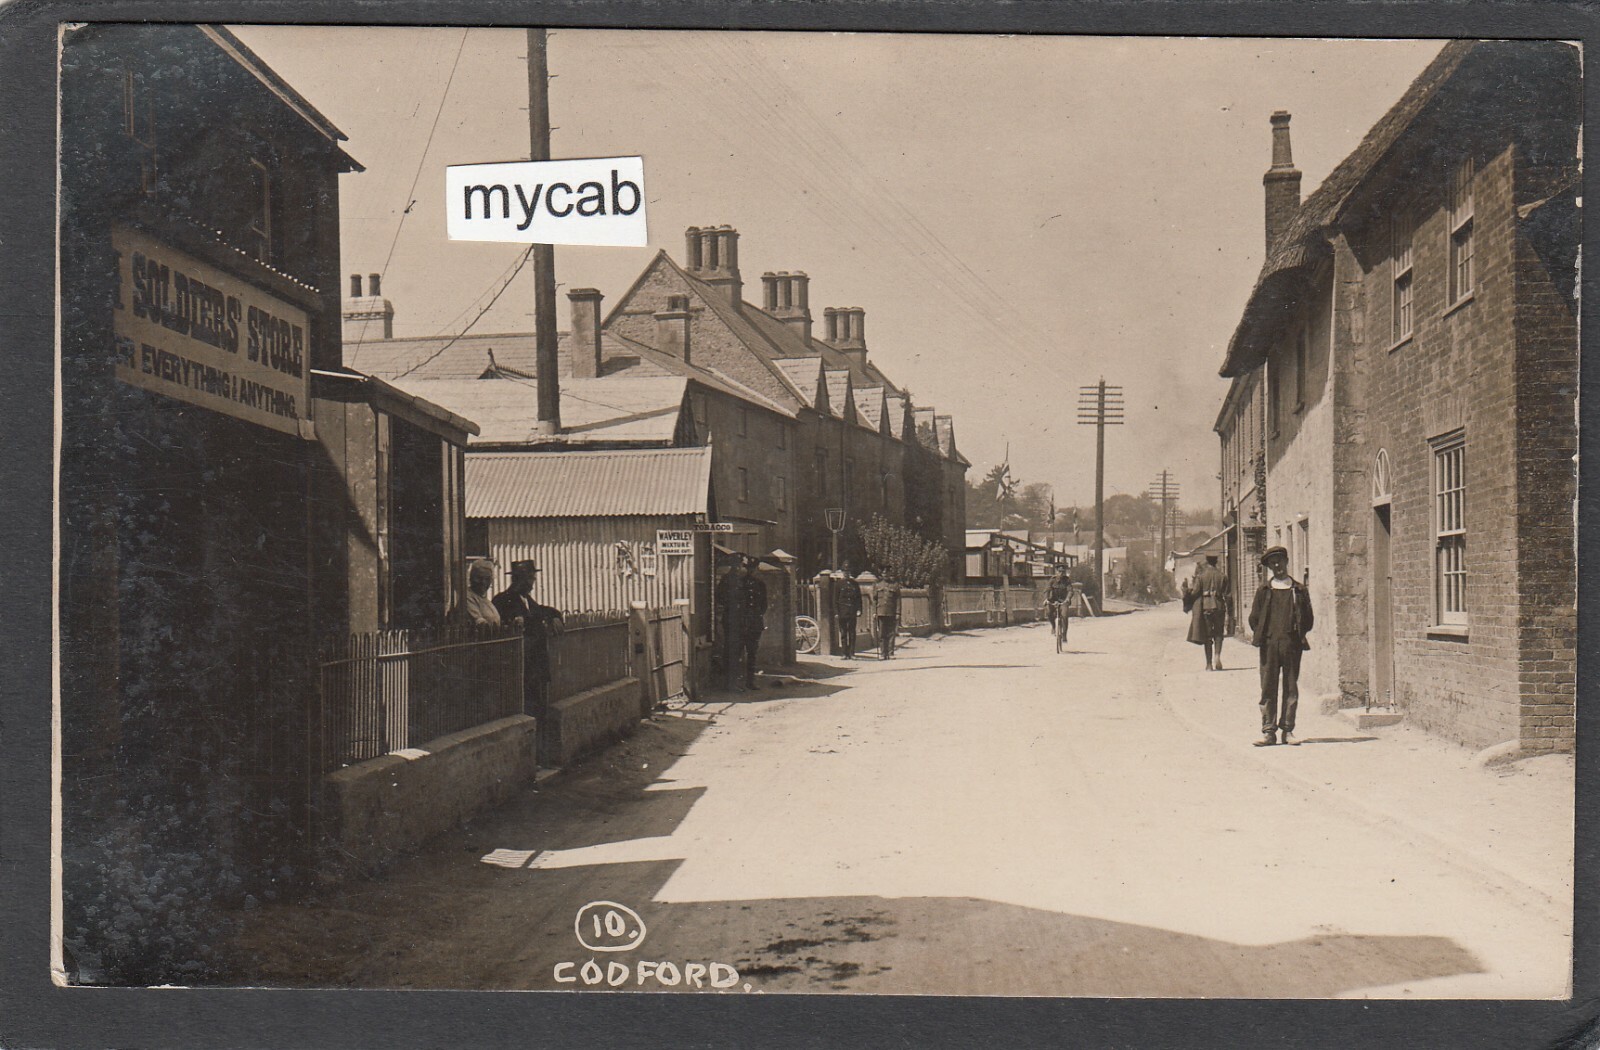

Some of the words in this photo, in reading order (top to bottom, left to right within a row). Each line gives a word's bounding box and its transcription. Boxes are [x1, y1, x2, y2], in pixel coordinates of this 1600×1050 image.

[246, 304, 304, 379] STORE
[693, 523, 731, 531] TOBACCO
[659, 531, 693, 541] WAVERLEY
